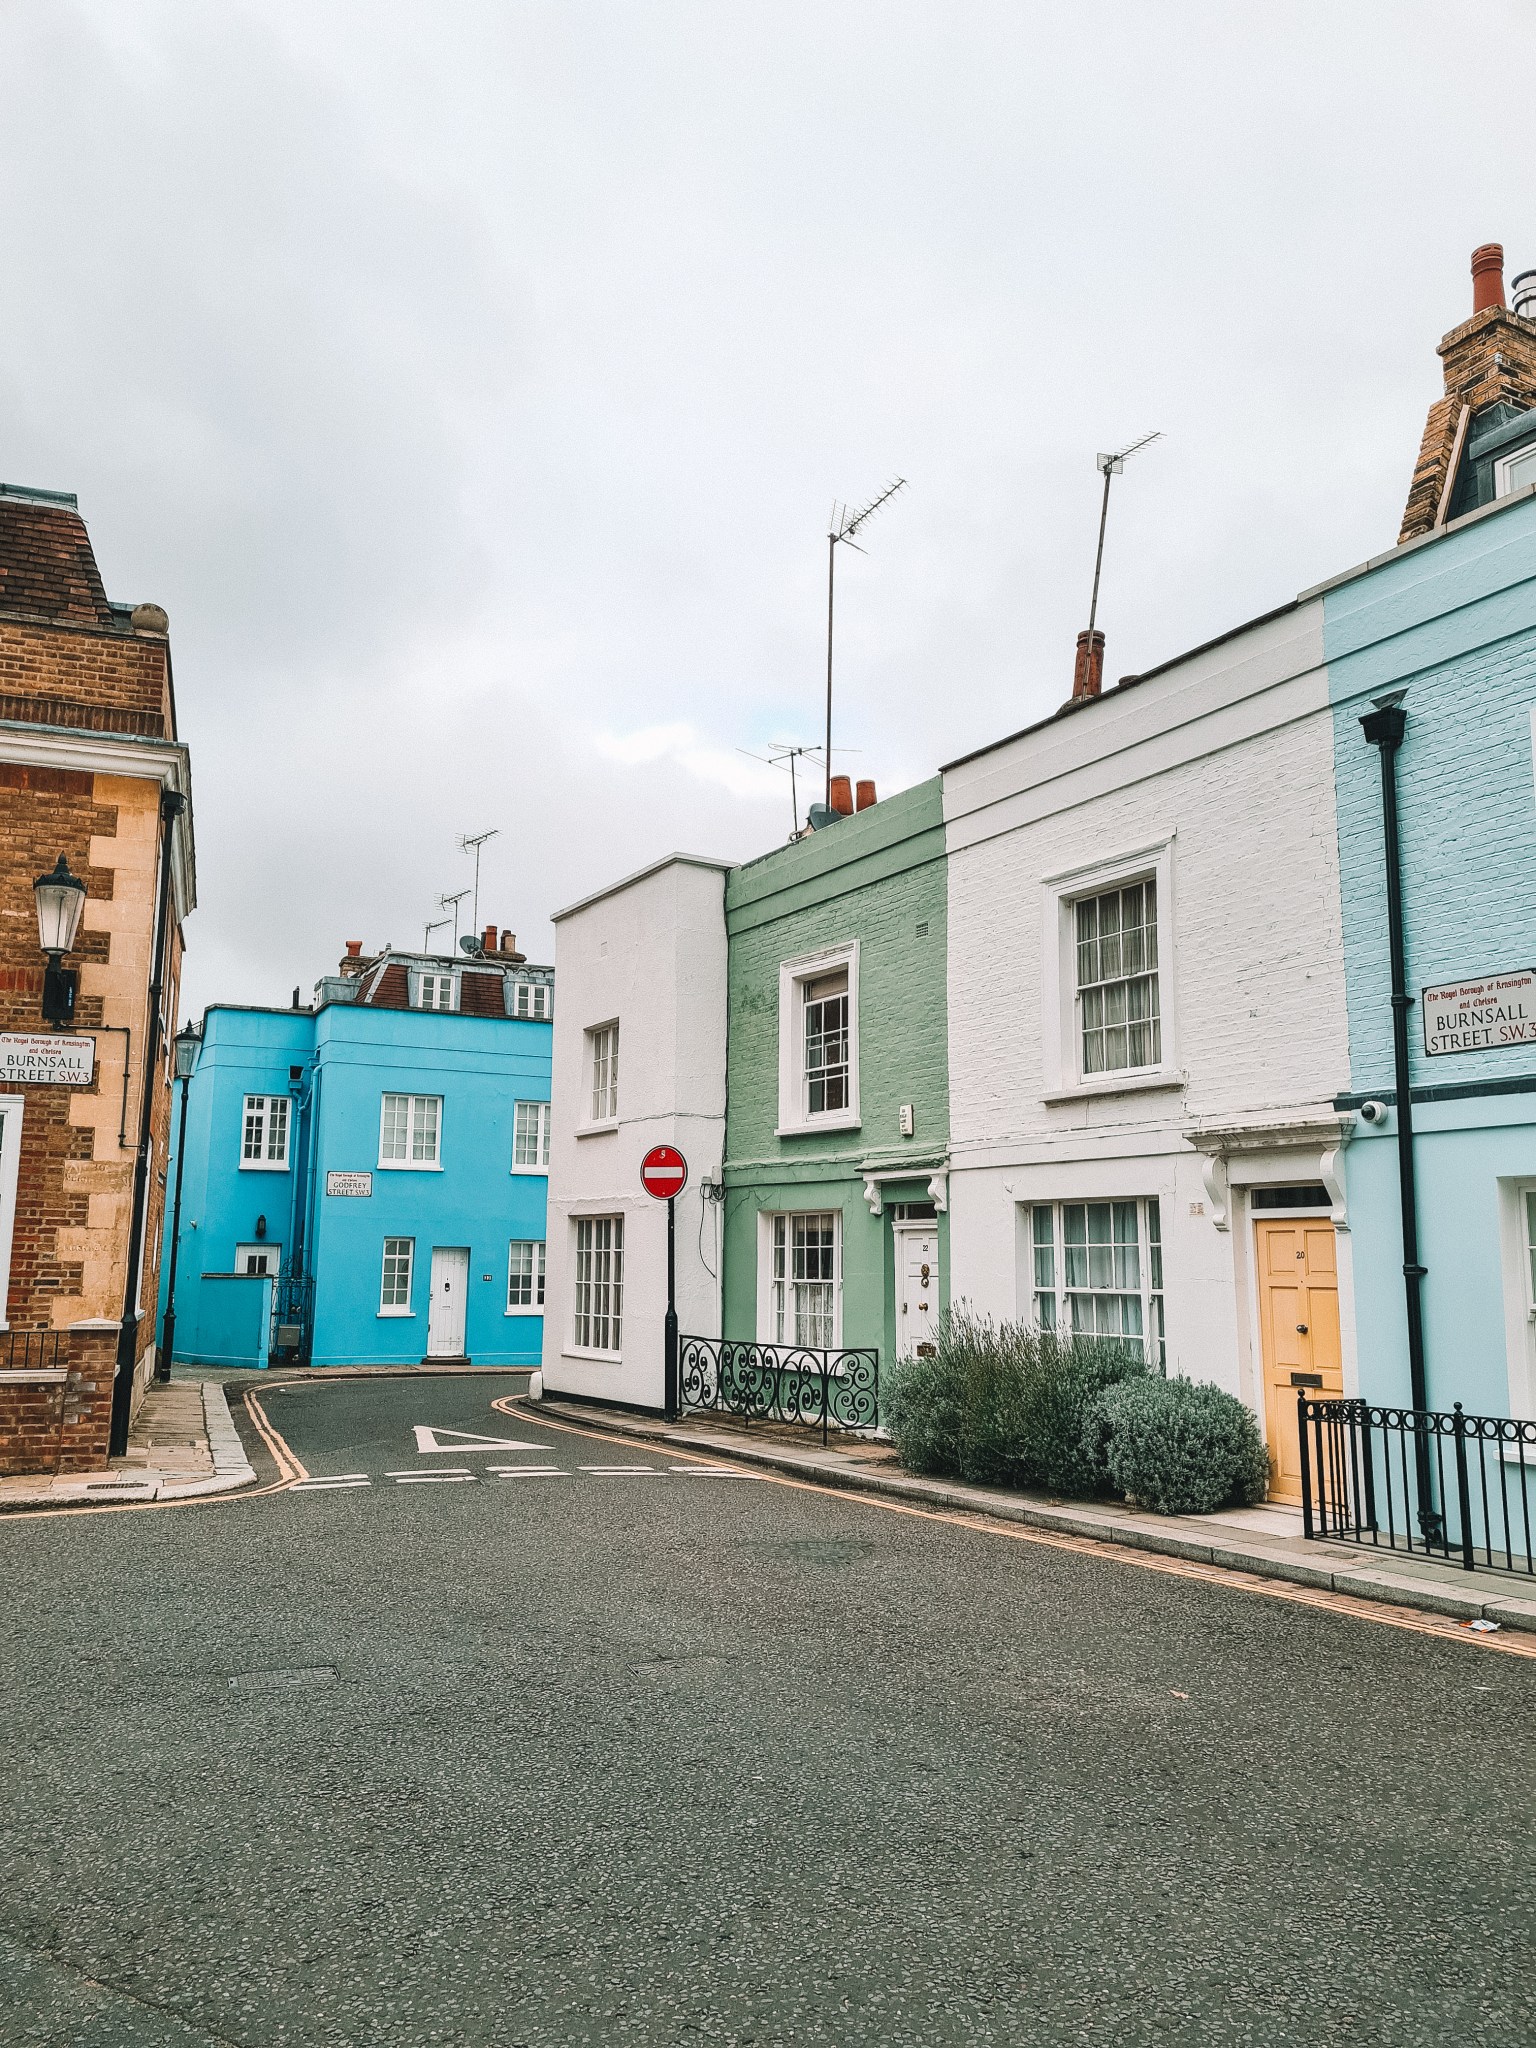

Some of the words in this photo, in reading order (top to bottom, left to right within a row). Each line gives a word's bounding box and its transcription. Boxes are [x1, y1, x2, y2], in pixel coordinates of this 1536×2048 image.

[1427, 993, 1439, 1002] The
[1440, 990, 1457, 1000] Royal
[1460, 985, 1484, 996] Borough
[1487, 983, 1494, 991] of
[1496, 978, 1532, 990] Kensington
[1459, 1000, 1470, 1009] and
[1473, 997, 1497, 1007] Chelsea
[1436, 1003, 1528, 1031] BURNSALL
[31, 1038, 52, 1046] Borough
[62, 1040, 91, 1048] Kensington
[7, 1055, 85, 1069] BURNSALL
[1296, 1251, 1305, 1259] 20
